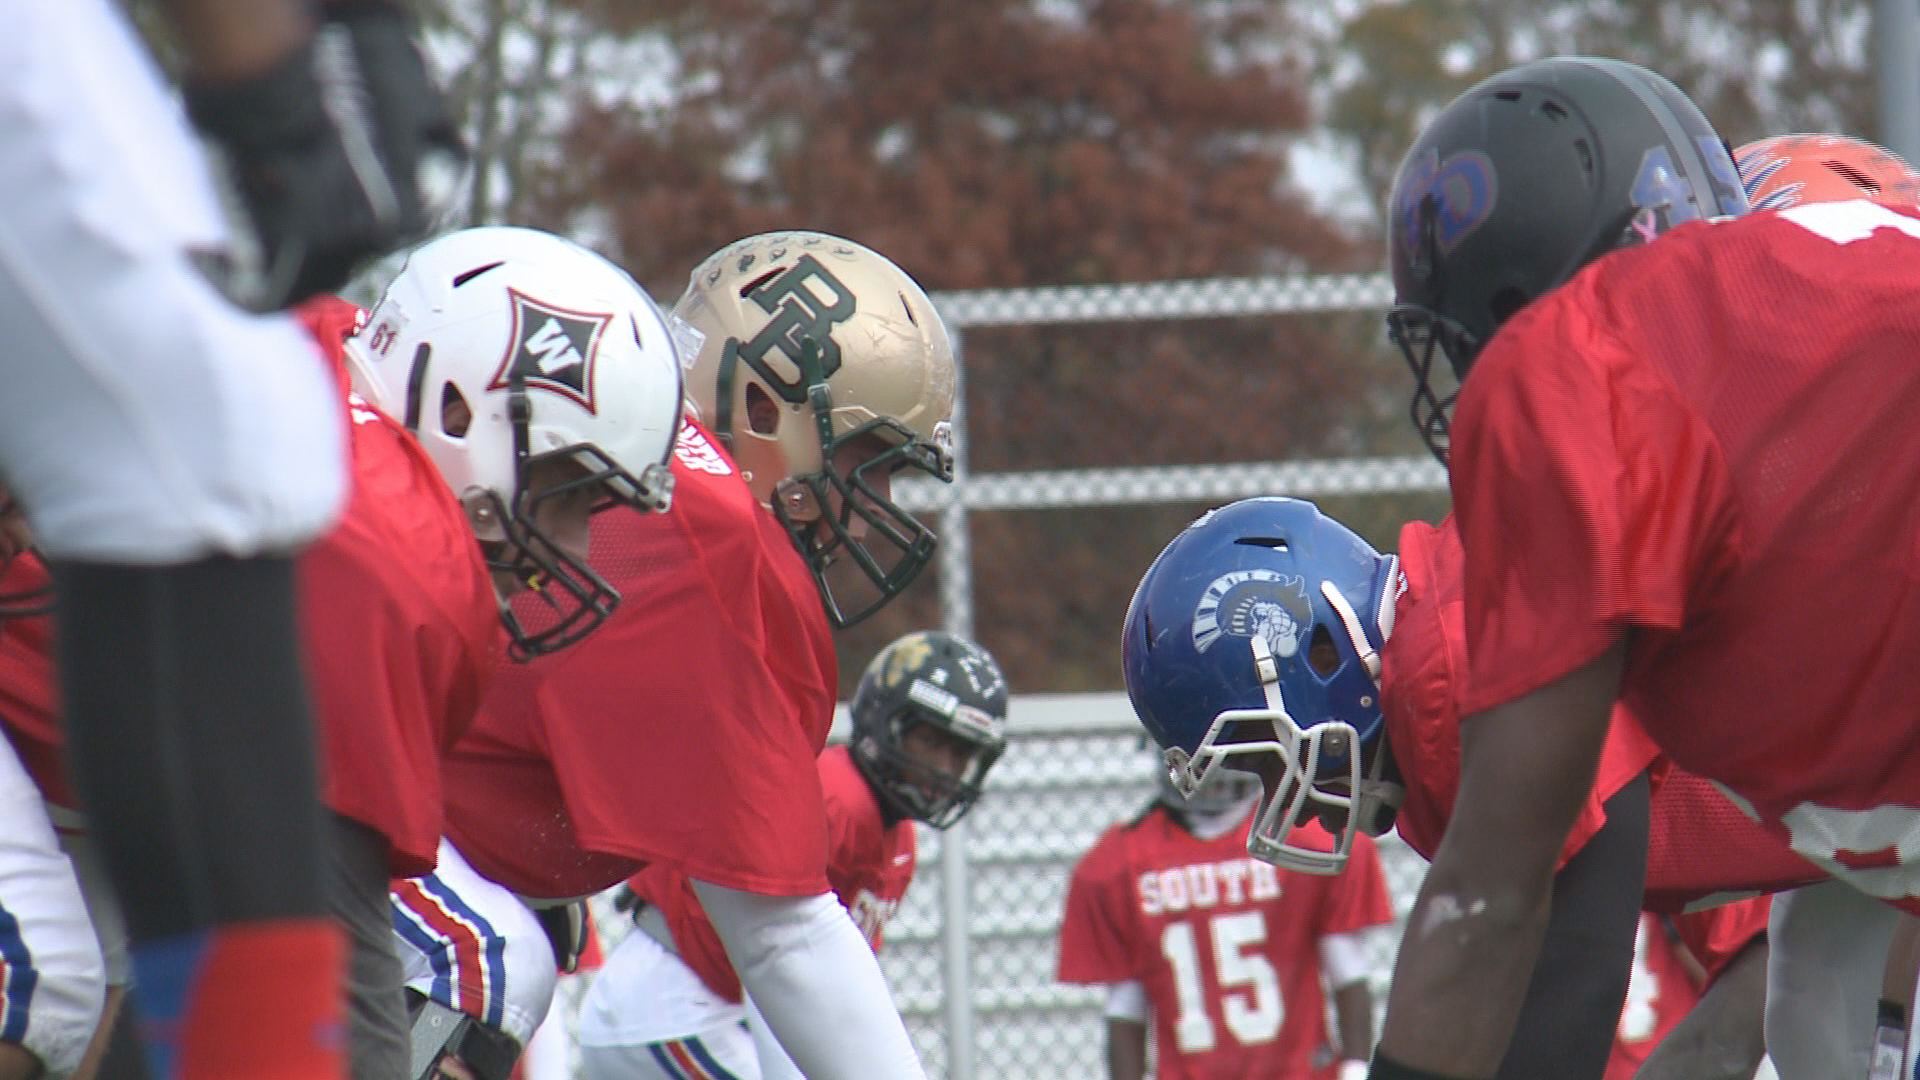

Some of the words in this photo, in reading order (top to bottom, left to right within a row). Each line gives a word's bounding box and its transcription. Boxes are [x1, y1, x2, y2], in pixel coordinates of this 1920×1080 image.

[369, 321, 398, 357] 61
[524, 316, 583, 374] W
[1137, 857, 1282, 915] SOUTH
[1160, 910, 1285, 1054] 15
